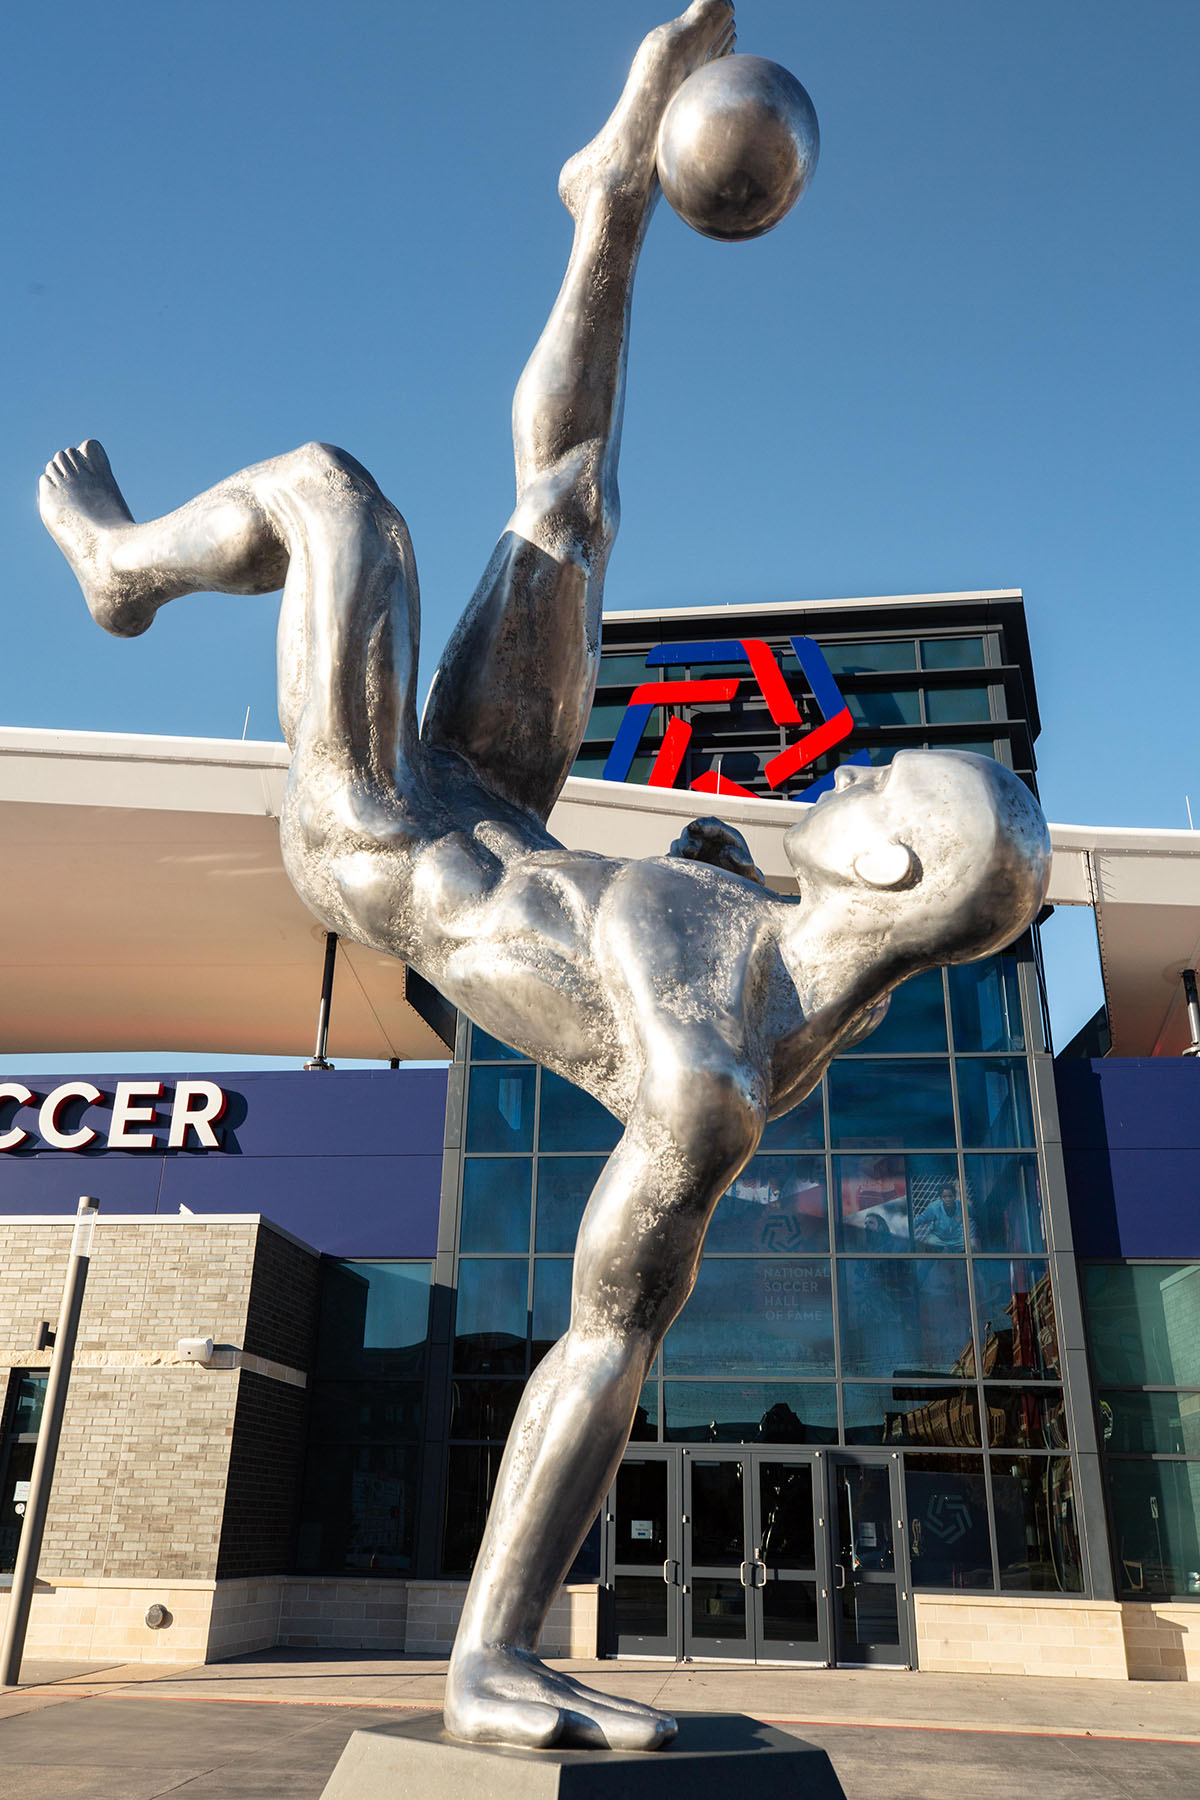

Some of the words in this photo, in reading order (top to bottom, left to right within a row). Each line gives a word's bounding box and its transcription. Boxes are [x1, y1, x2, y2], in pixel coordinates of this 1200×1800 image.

[764, 1267, 831, 1279] NATIONAL
[764, 1281, 819, 1292] SOCCER
[764, 1295, 800, 1307] HALL
[765, 1310, 783, 1321] OF
[787, 1310, 823, 1321] FAME
